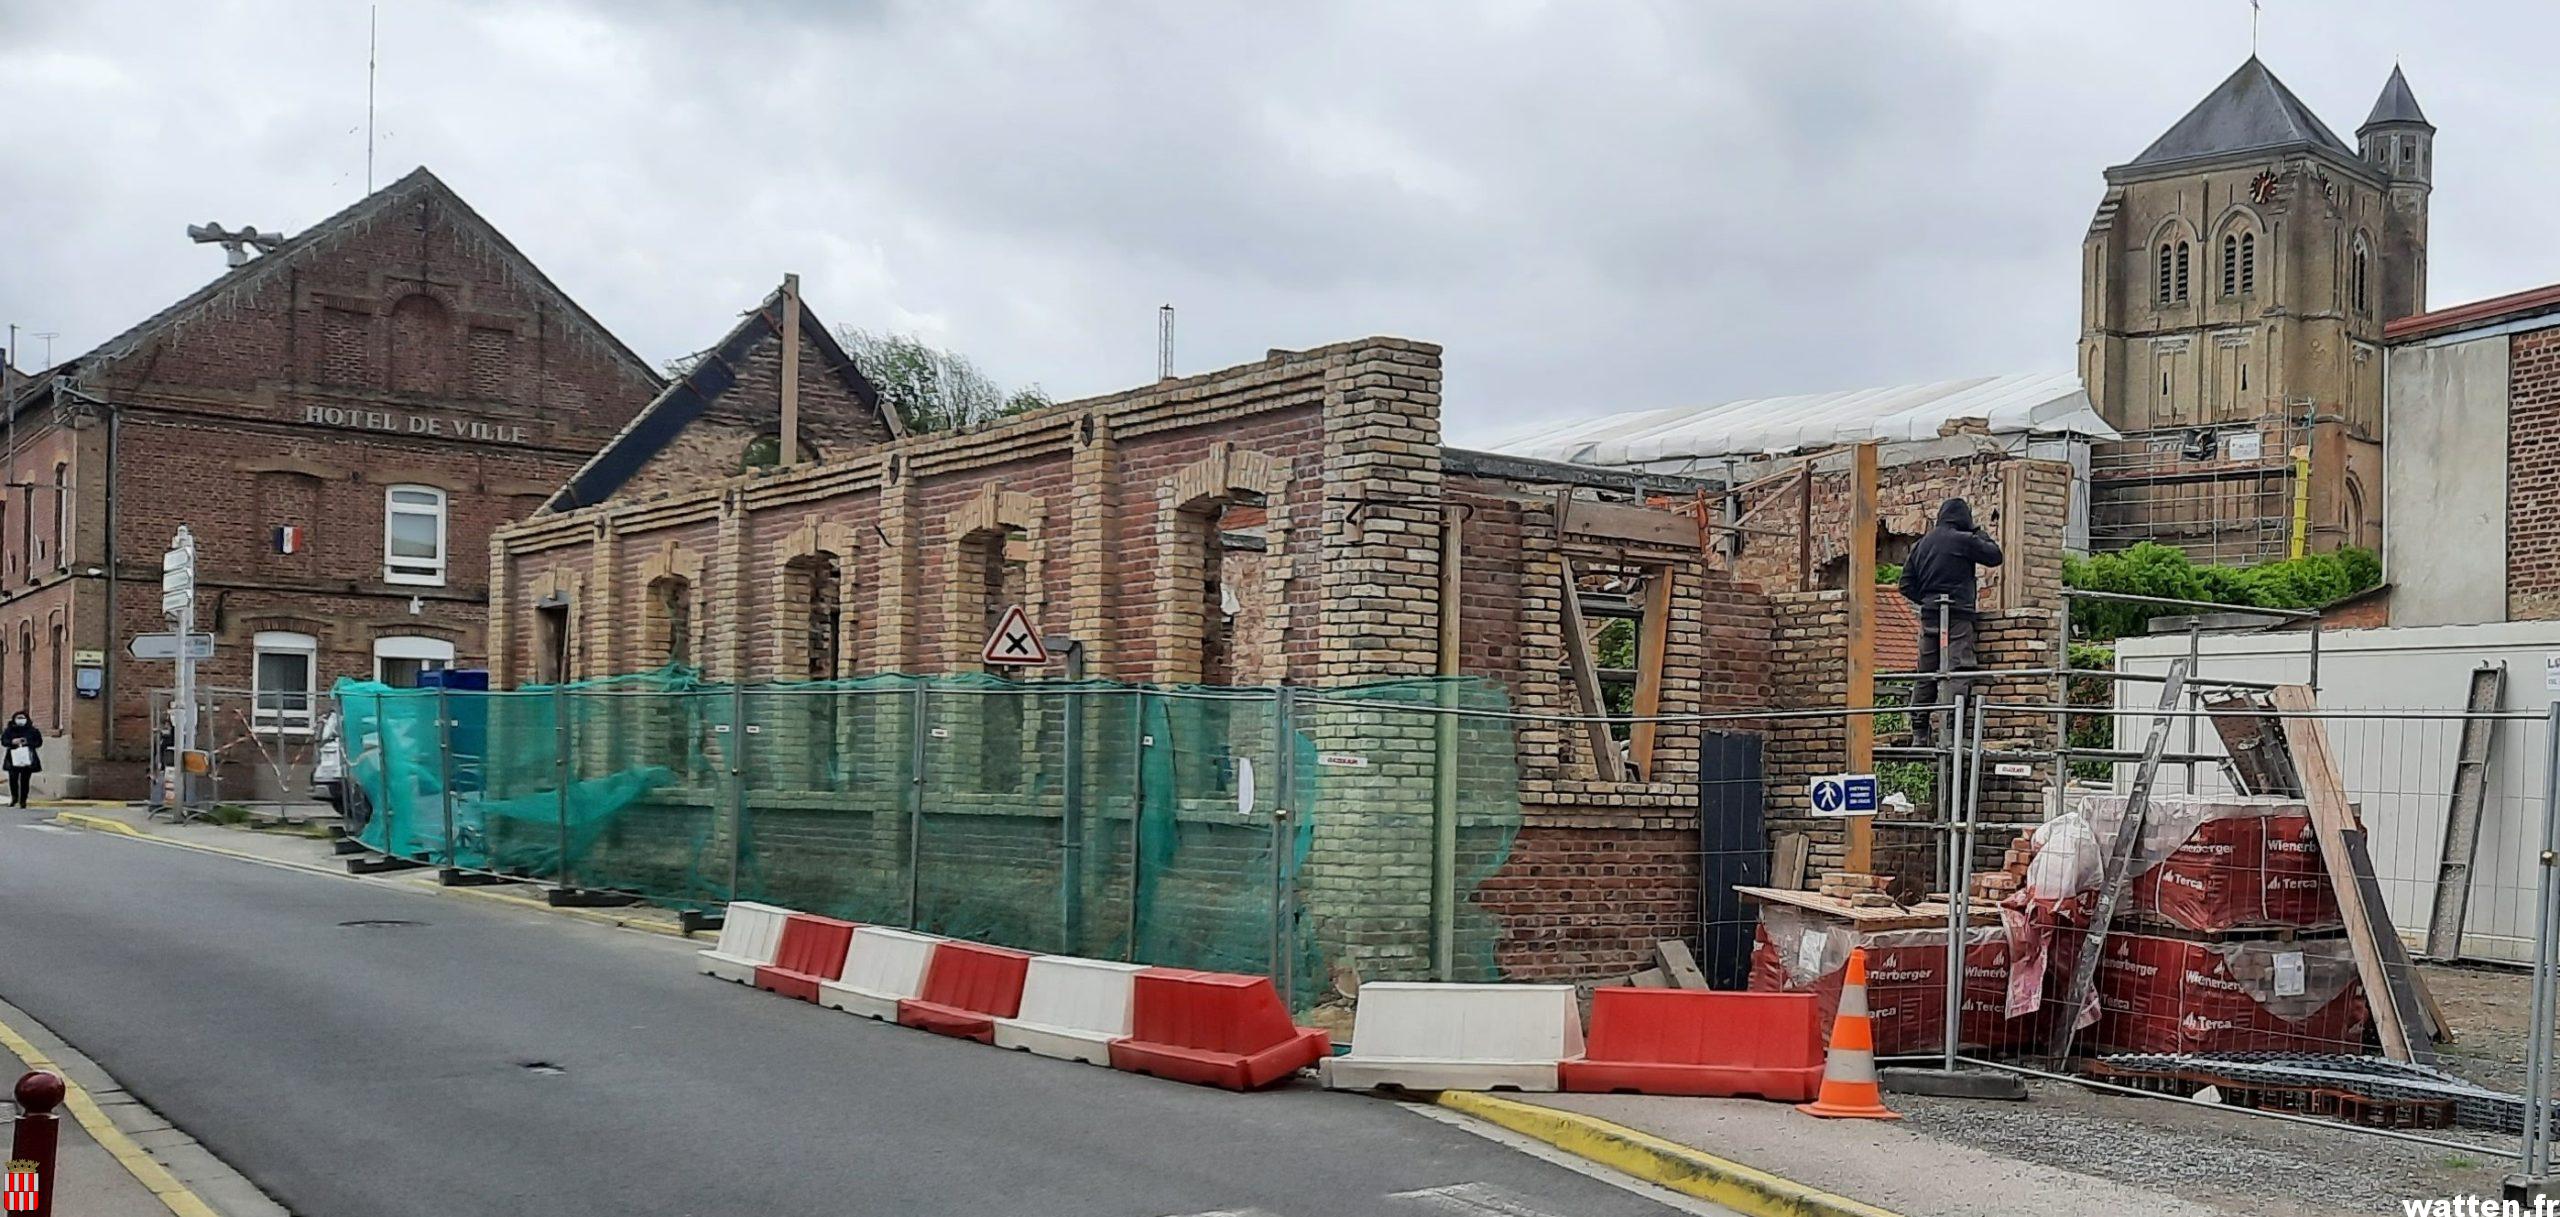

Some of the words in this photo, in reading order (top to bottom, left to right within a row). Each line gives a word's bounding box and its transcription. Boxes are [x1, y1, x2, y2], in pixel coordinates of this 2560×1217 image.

[305, 405, 397, 431] HOTEL
[408, 416, 442, 435] DE
[452, 419, 529, 444] VILLE
[2267, 839, 2316, 853] Wienerb
[2283, 878, 2317, 889] Terca
[1865, 969, 1932, 980] enerberger
[1965, 966, 2007, 978] Wienerb
[1868, 1007, 1896, 1018] erca
[2198, 1016, 2232, 1030] Terca
